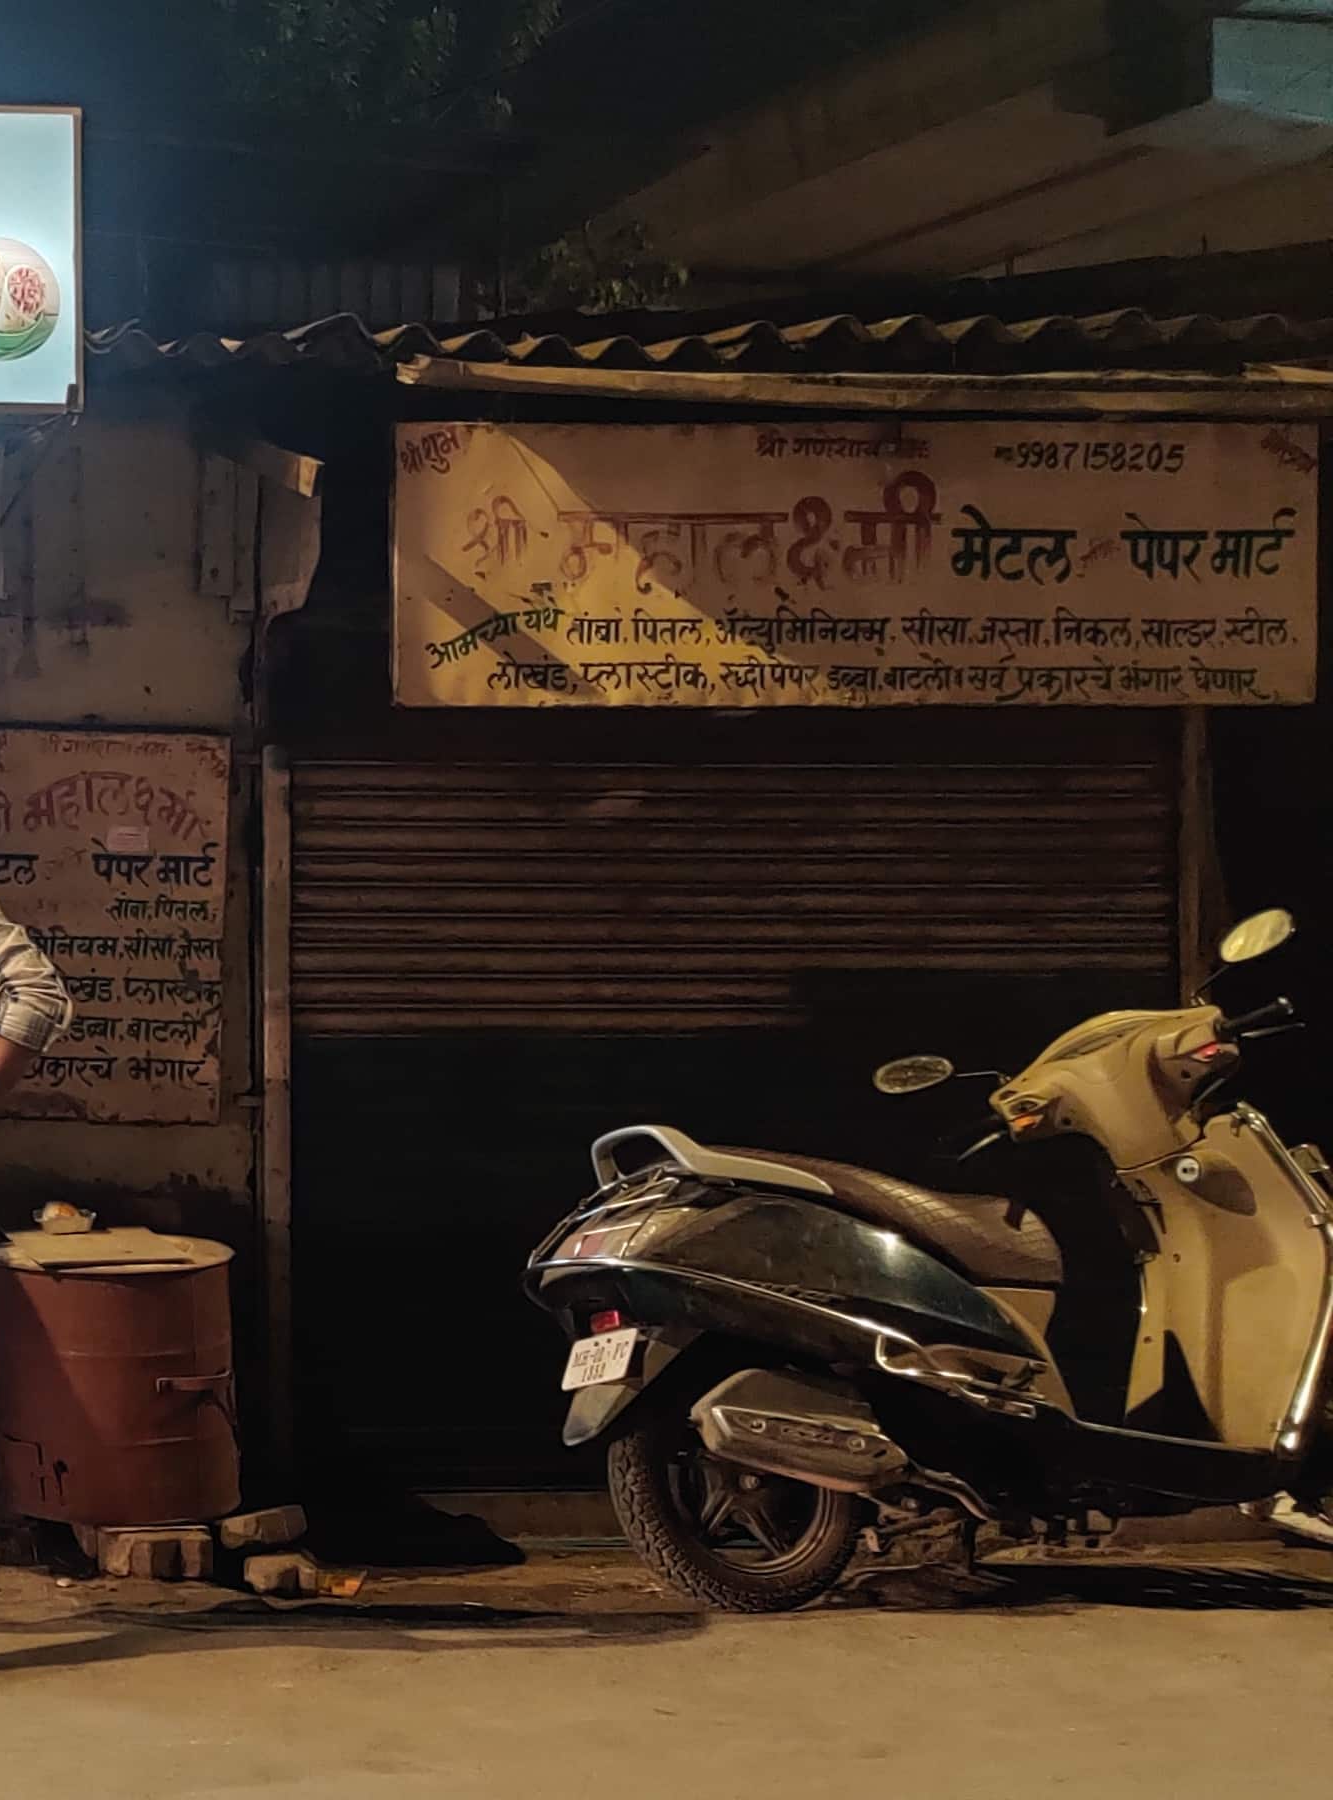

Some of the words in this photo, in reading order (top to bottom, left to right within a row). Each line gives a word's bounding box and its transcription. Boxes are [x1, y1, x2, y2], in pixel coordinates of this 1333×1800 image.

[1016, 441, 1186, 474] 9987158205
[951, 504, 1078, 587] मेटल
[1121, 512, 1209, 584] पेपर
[1211, 506, 1298, 579] मार्ट
[91, 837, 154, 887] पेपर
[156, 841, 219, 887] मार्ट
